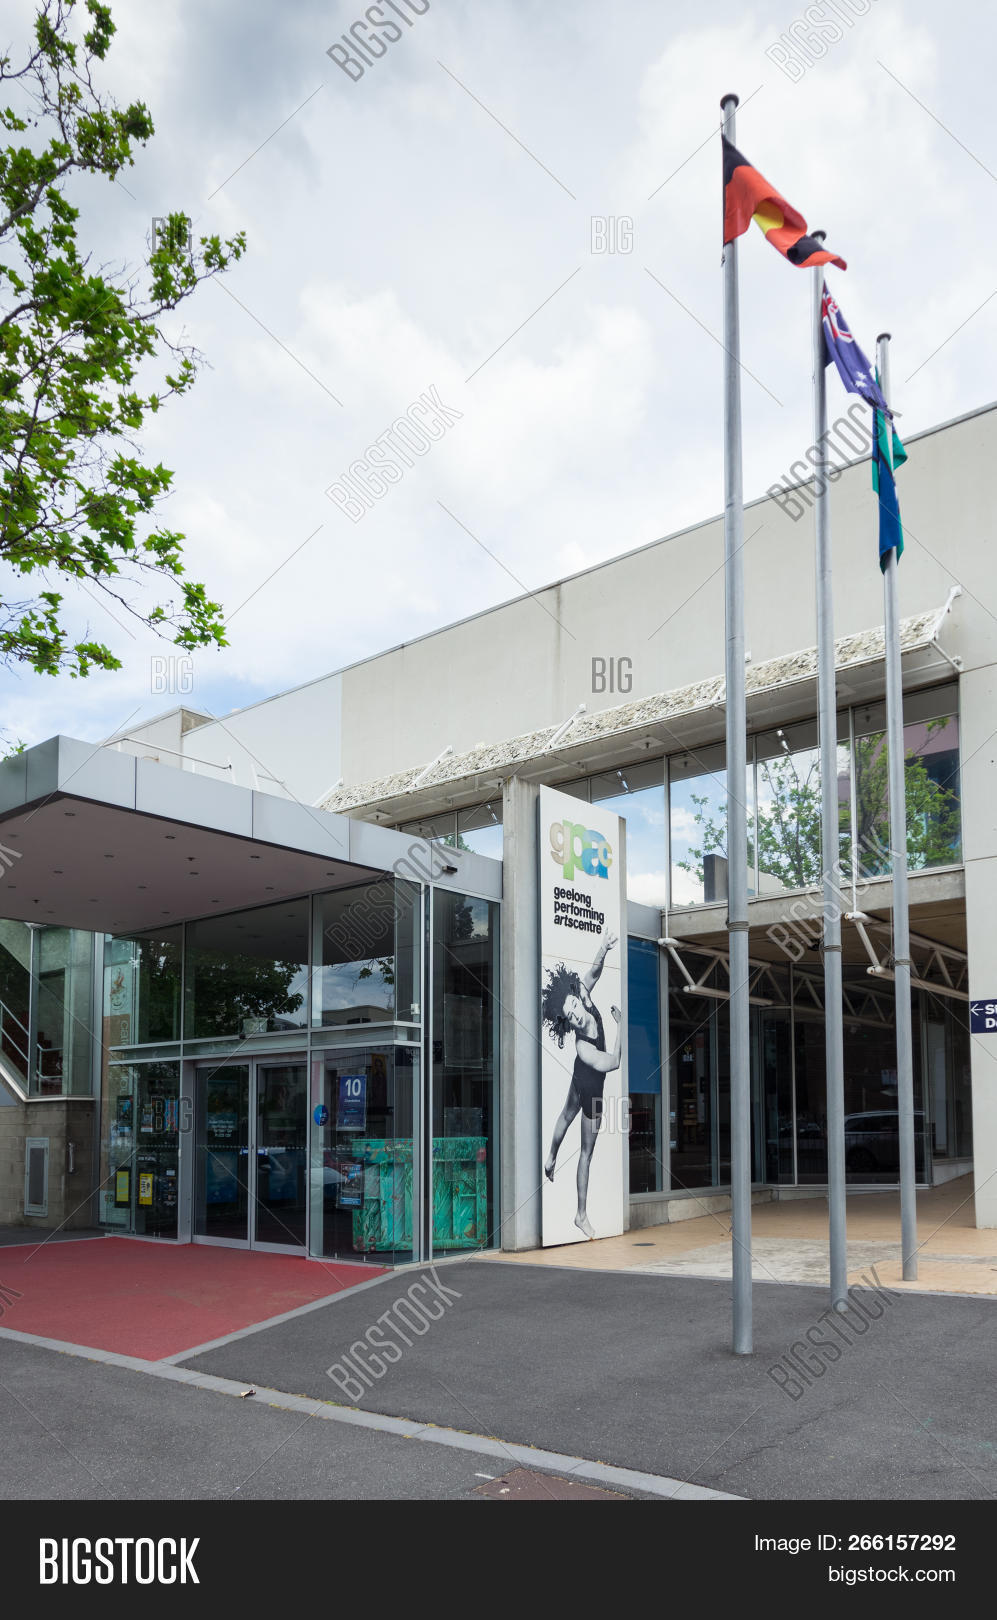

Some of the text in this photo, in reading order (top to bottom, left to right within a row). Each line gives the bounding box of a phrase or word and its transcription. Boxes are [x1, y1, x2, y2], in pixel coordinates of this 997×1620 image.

[553, 886, 591, 908] geelong
[553, 900, 605, 925] performing
[553, 914, 602, 935] artscentre
[345, 1078, 362, 1097] 10
